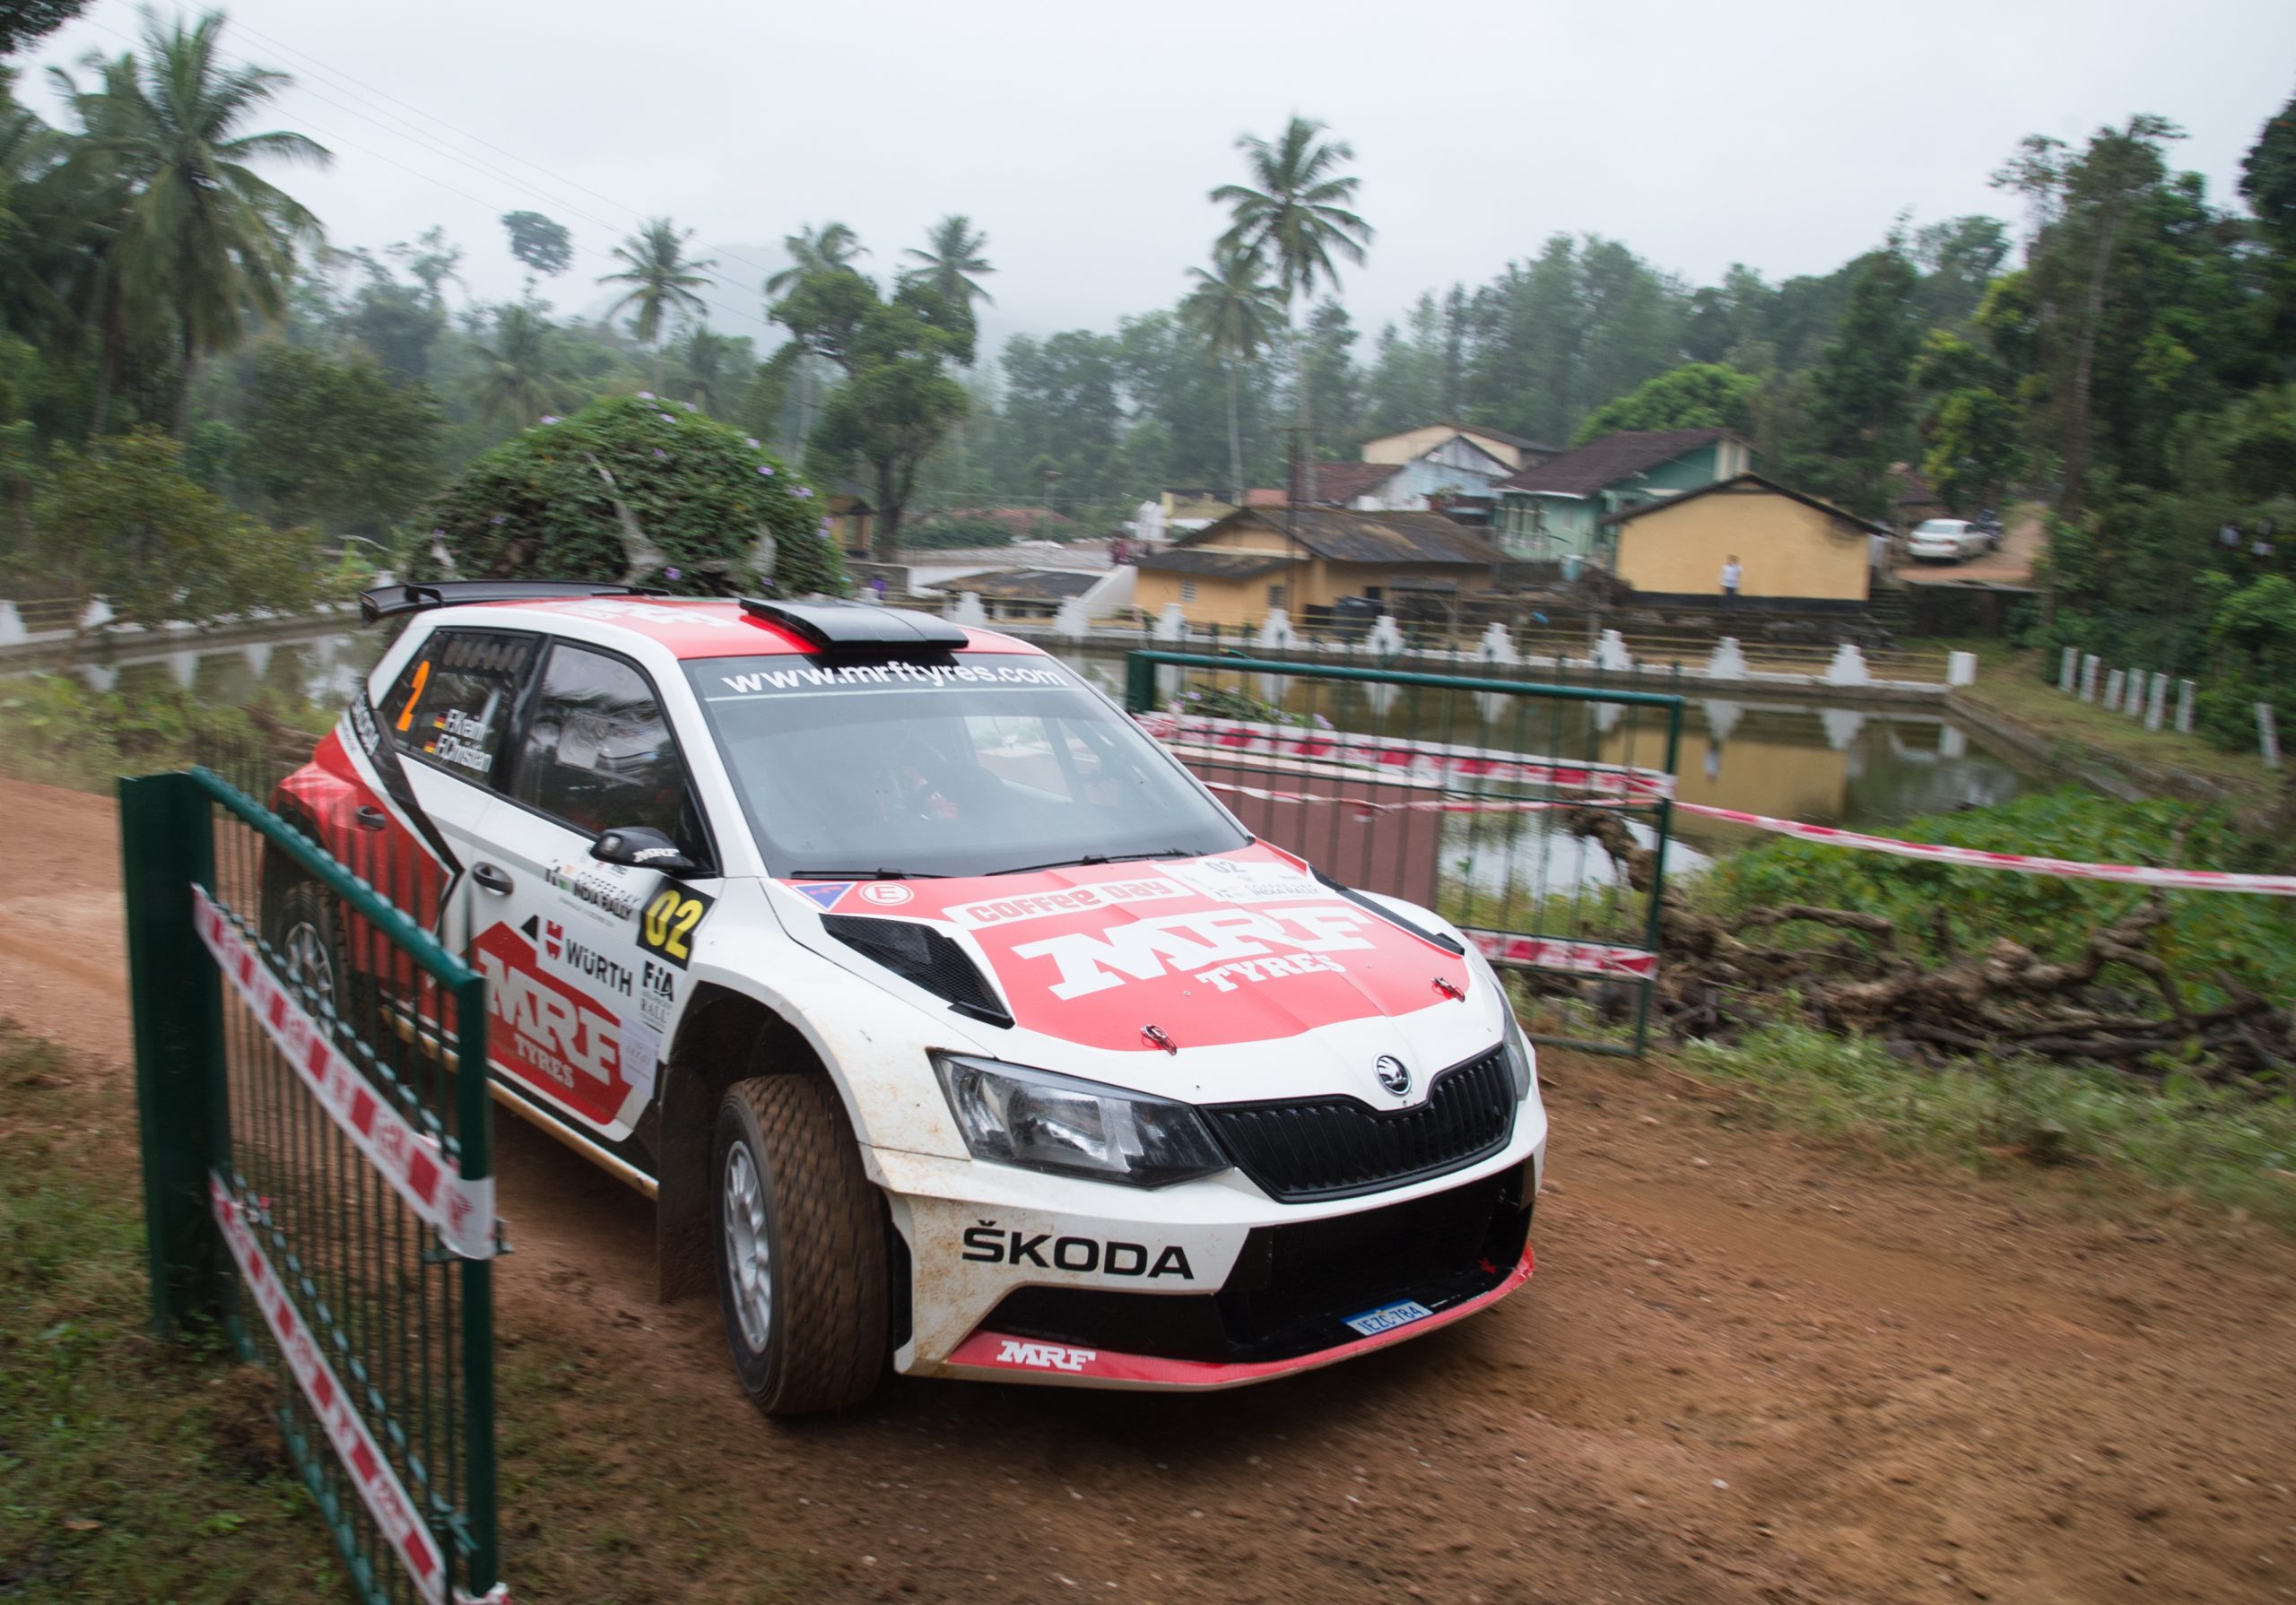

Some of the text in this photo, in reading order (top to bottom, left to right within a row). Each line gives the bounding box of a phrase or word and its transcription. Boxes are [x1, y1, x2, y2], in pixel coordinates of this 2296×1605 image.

[720, 660, 1069, 694] www.mrftyres.com
[1205, 861, 1246, 873] 02
[645, 889, 703, 960] 02
[1011, 905, 1378, 1001] MRF
[1196, 952, 1347, 993] TYRES
[477, 947, 623, 1087] MRF
[513, 1032, 576, 1089] TYRES
[961, 1219, 1195, 1280] ŠKODA
[996, 1340, 1096, 1372] MRF
